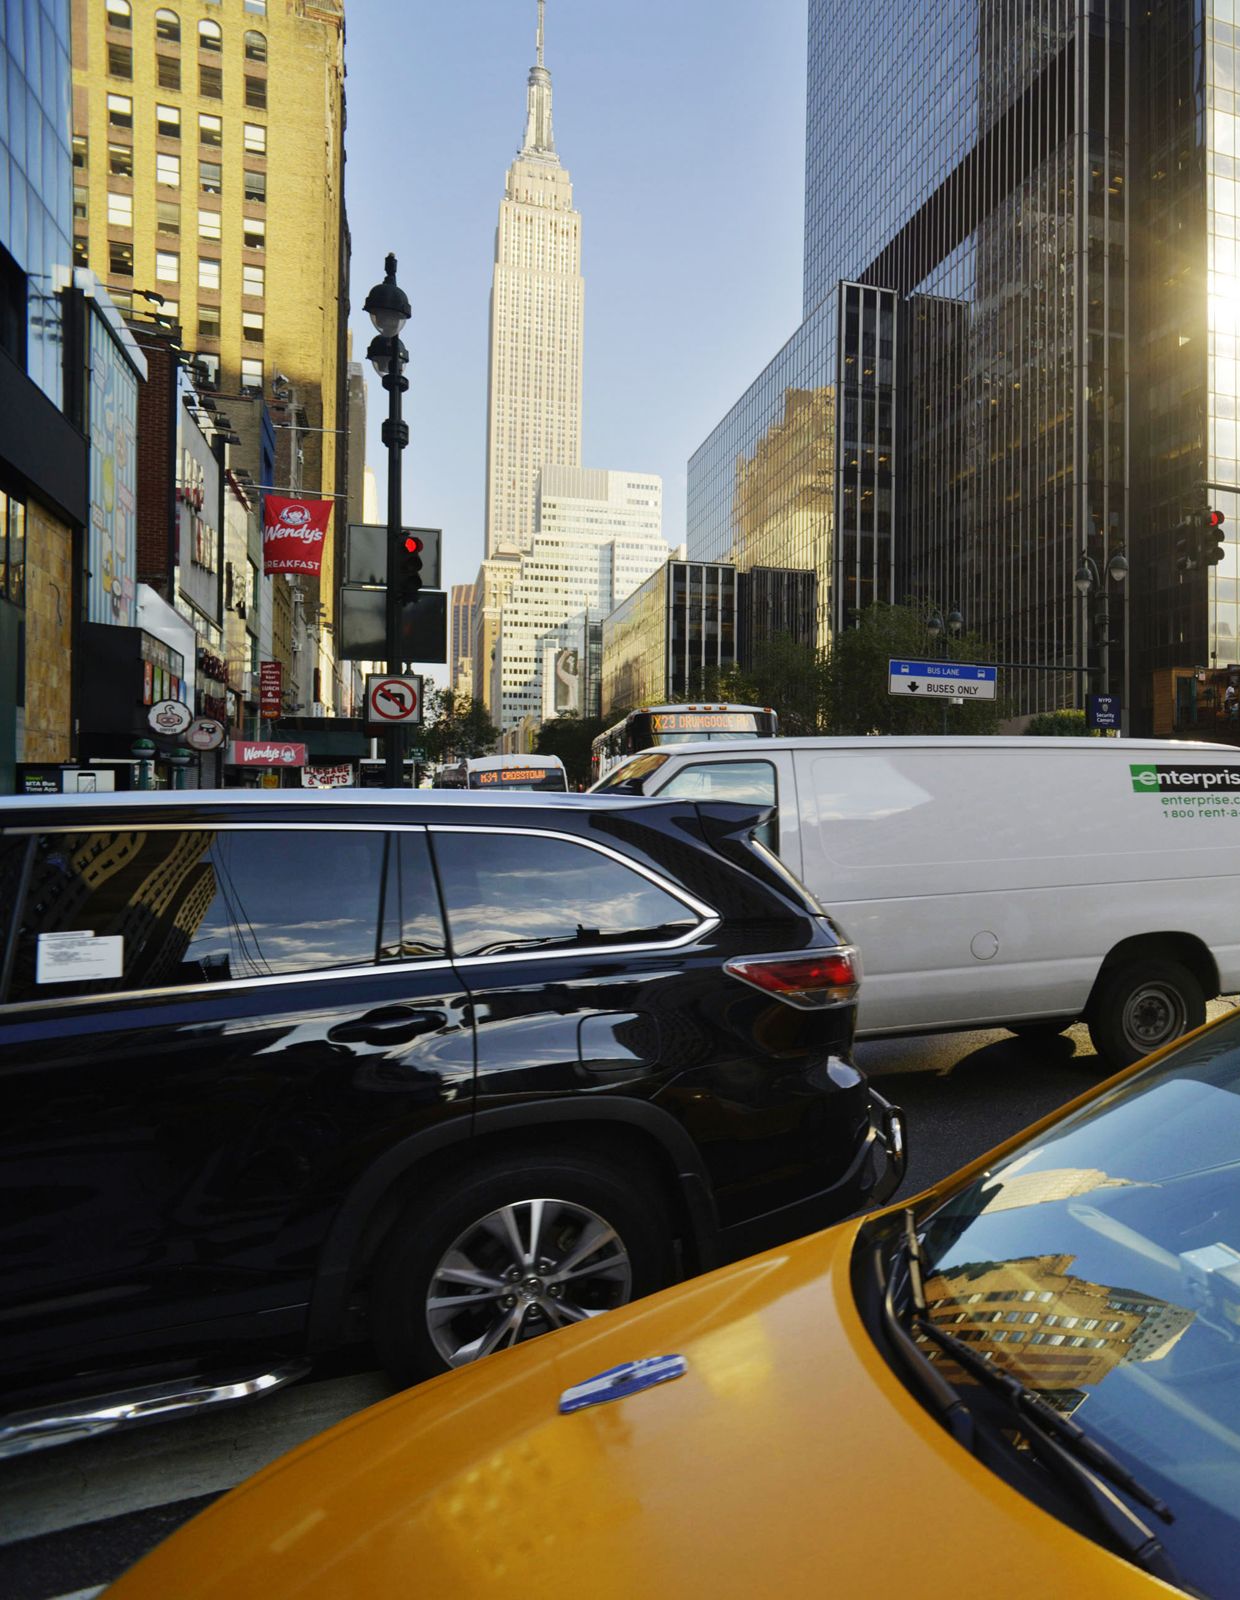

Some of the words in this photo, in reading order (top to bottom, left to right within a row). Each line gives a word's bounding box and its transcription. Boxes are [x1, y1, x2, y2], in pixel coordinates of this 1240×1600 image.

[265, 524, 323, 544] Wendy's
[927, 666, 940, 674] BUS
[942, 668, 960, 676] LANE
[926, 683, 955, 693] BUSES
[957, 686, 979, 695] ONLY
[654, 714, 676, 729] X23
[244, 746, 279, 762] Wendy's
[304, 764, 350, 775] LUGGAGE
[501, 769, 546, 781] CROSSTOWN
[319, 775, 347, 785] GIFTS
[1171, 810, 1194, 818] 800
